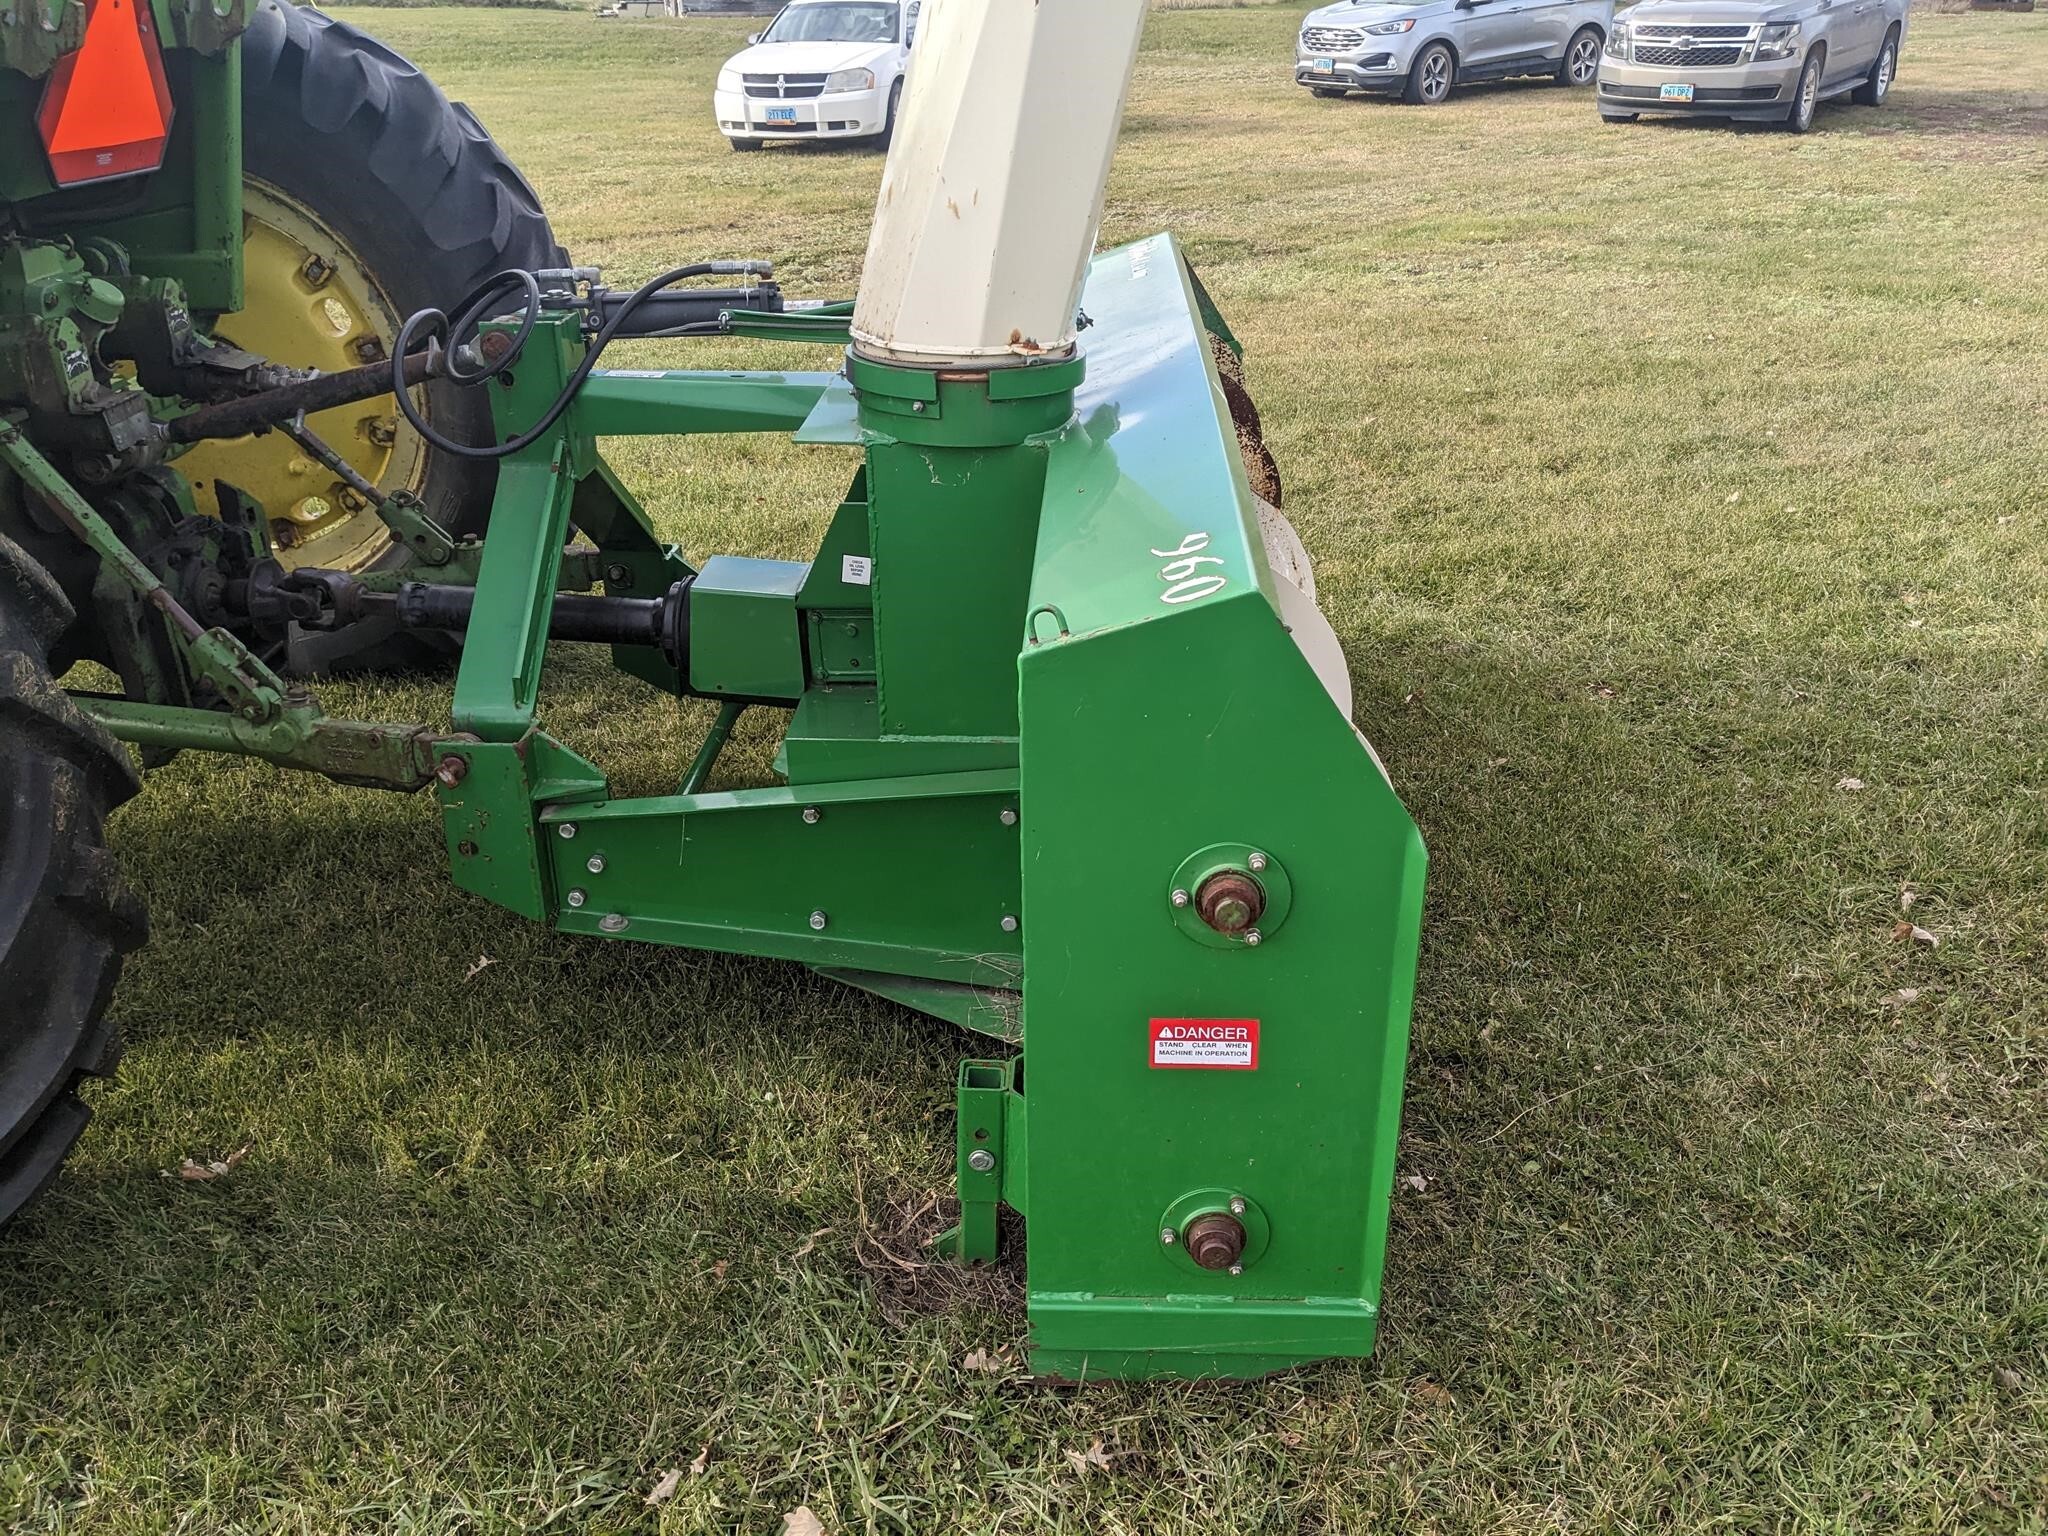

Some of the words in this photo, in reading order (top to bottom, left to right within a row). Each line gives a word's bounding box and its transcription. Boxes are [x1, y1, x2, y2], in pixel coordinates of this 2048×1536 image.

[1663, 88, 1676, 96] 961
[768, 111, 779, 120] 211
[781, 111, 793, 120] ELE
[1174, 1026, 1248, 1039] DANGER
